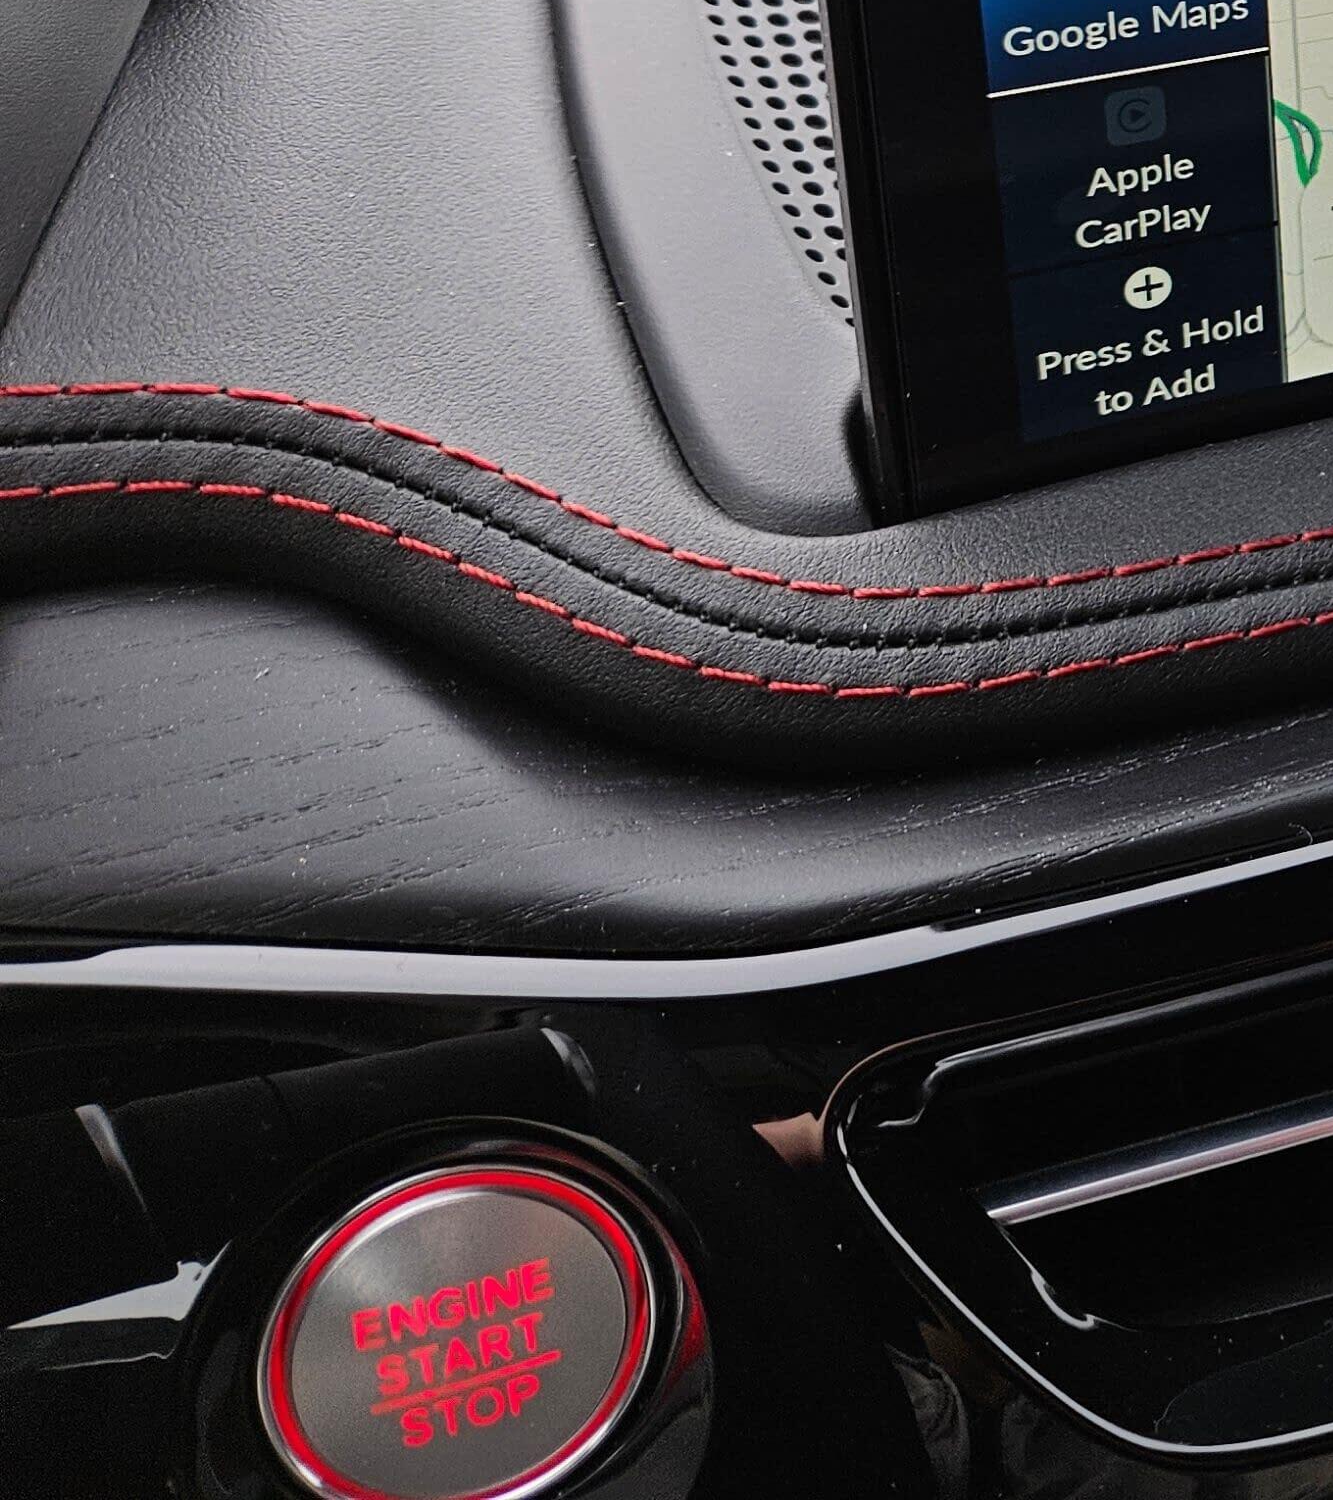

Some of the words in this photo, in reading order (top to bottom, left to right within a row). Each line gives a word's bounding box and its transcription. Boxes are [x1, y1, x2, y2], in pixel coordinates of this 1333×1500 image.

[1003, 12, 1140, 57] Google
[1087, 155, 1195, 198] Apple
[1075, 203, 1211, 249] CarPlay
[1037, 342, 1133, 380] Press
[1141, 329, 1172, 357] &
[1182, 306, 1265, 347] Hold
[1095, 388, 1133, 416] to
[1143, 365, 1216, 404] Add
[351, 1258, 555, 1352] ENGINE
[377, 1312, 545, 1395] START
[400, 1374, 540, 1449] STOP
